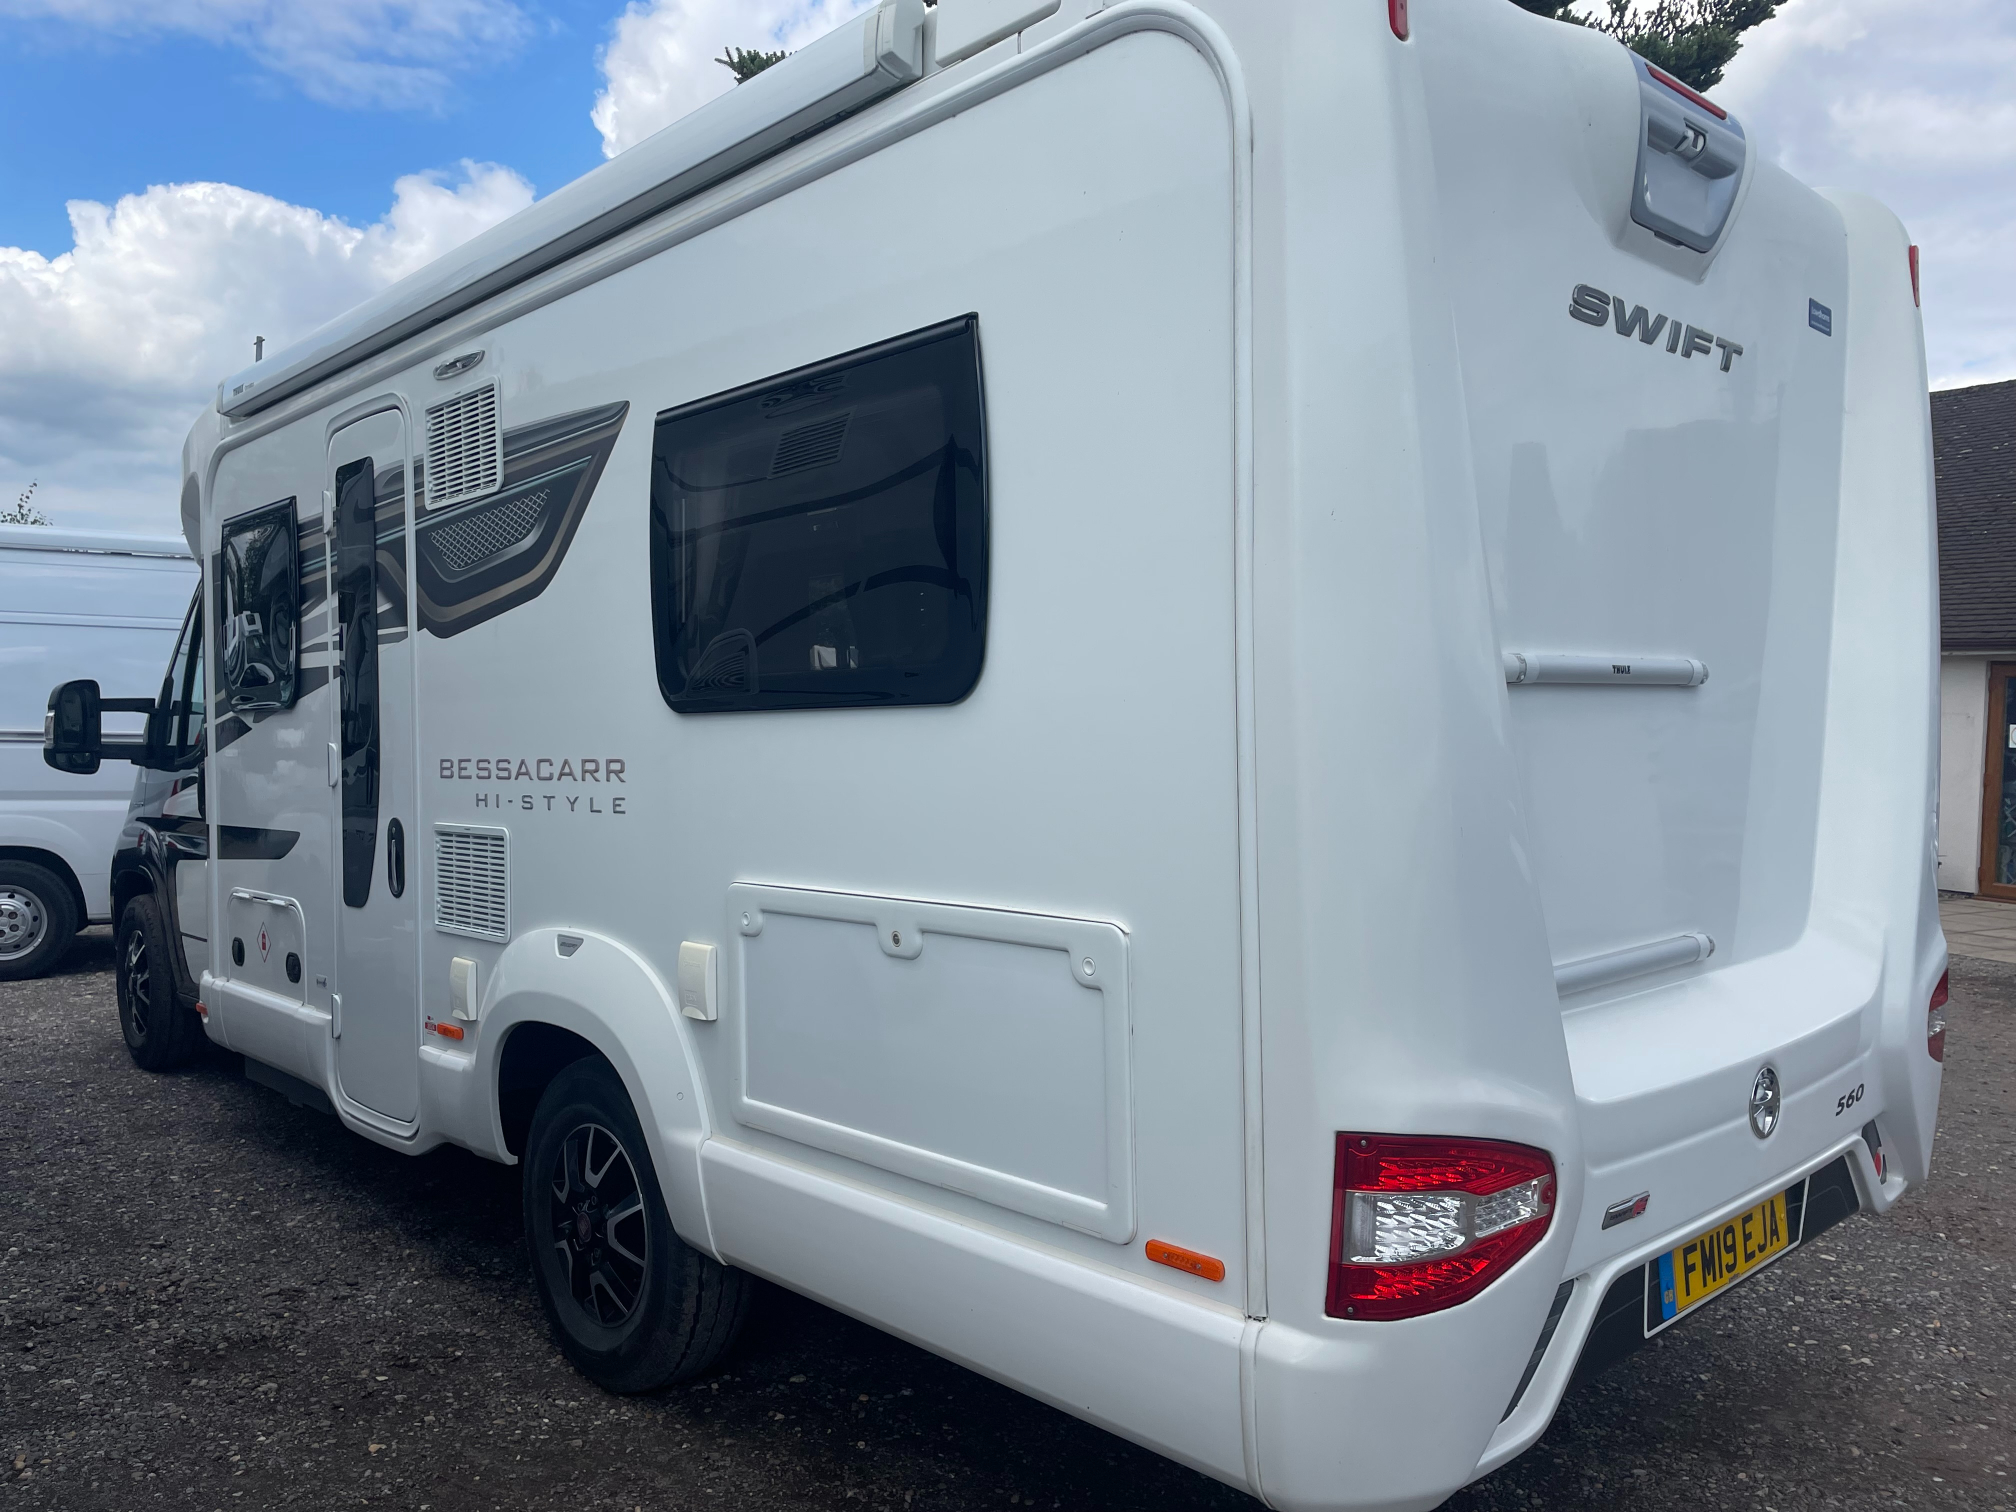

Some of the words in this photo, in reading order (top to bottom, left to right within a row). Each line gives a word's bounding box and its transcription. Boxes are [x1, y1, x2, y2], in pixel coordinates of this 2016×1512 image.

[1568, 283, 1743, 373] SWIFT
[1612, 665, 1631, 674] THULE
[440, 758, 626, 783] BESSACARR
[475, 793, 626, 814] HI-STYLE
[1835, 1083, 1864, 1116] 560
[1682, 1225, 1737, 1297] FM19
[1742, 1199, 1780, 1264] EJA
[1664, 1289, 1673, 1304] GB
